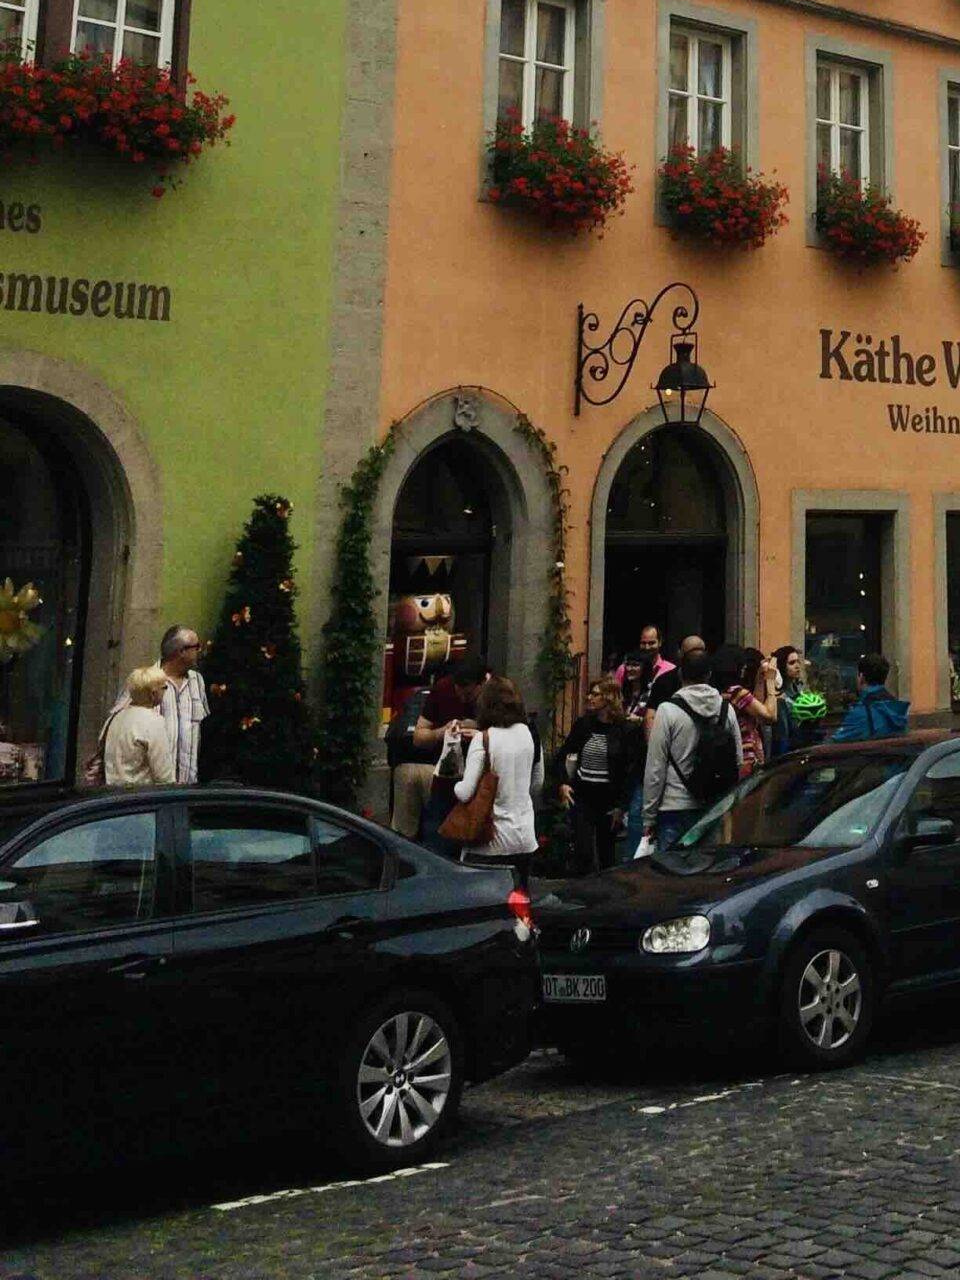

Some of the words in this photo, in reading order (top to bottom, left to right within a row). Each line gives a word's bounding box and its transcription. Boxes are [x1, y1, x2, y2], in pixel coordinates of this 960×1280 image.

[0, 200, 42, 234] es
[0, 271, 171, 322] museum
[818, 328, 937, 387] Käthe
